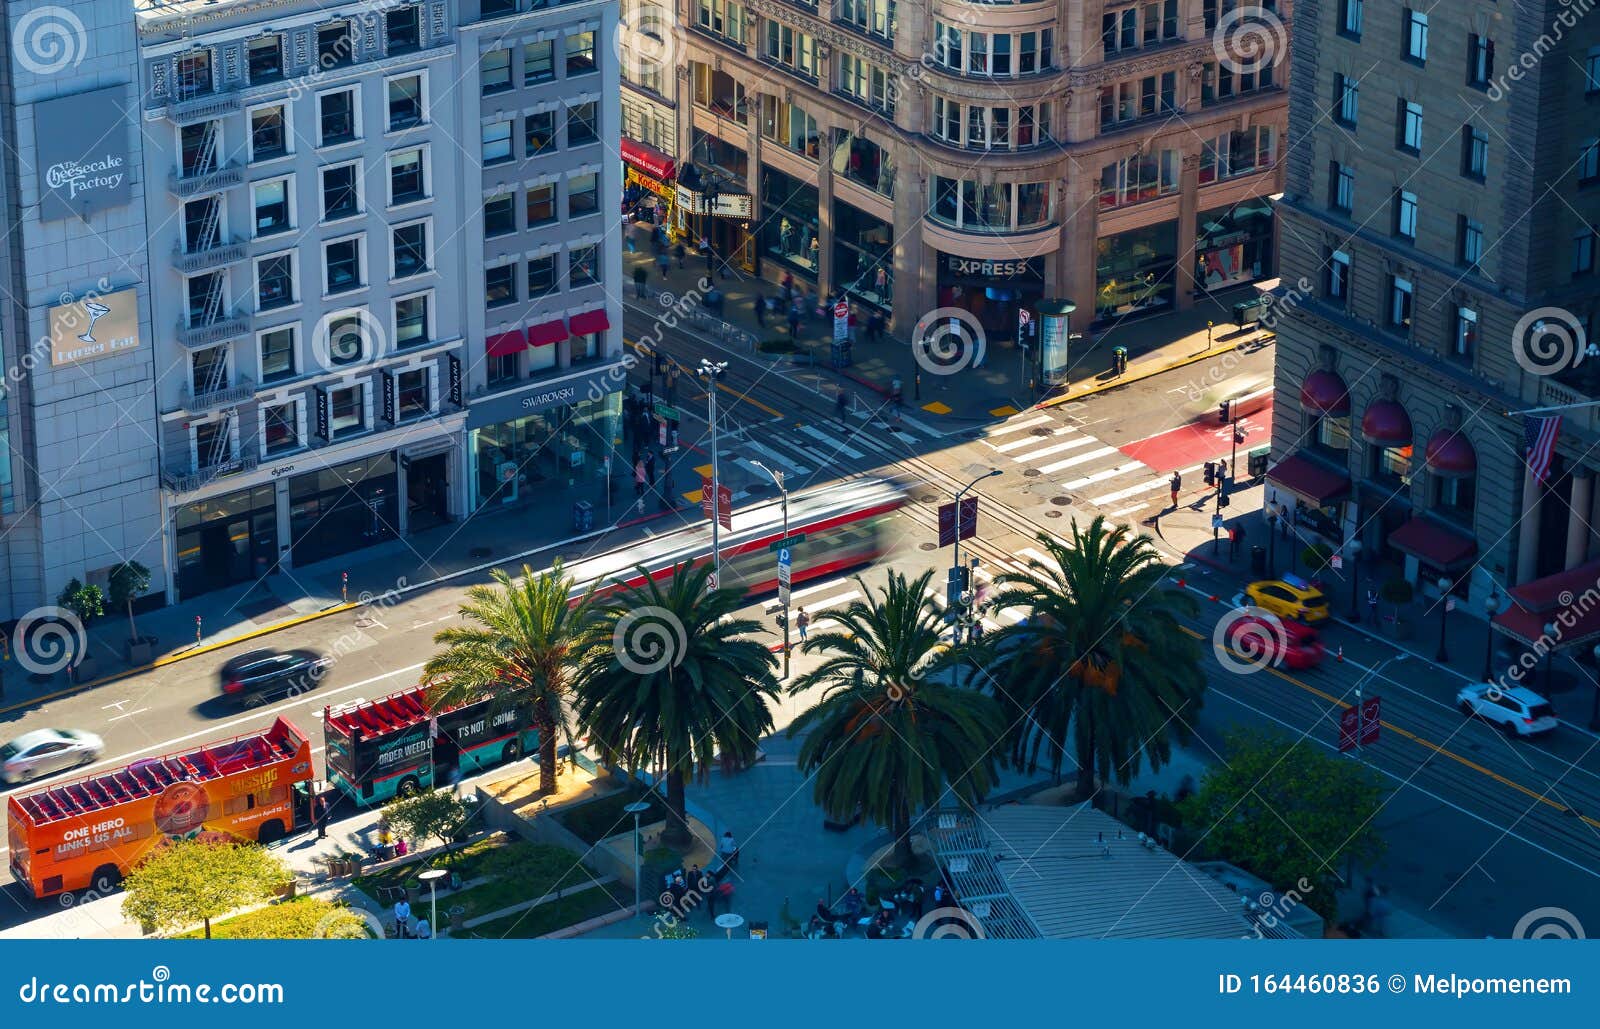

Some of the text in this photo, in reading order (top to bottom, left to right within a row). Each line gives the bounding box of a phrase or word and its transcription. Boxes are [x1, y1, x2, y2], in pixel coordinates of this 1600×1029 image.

[46, 155, 122, 188] Cheesecake
[62, 173, 123, 200] Factory
[637, 173, 661, 194] Kodak
[948, 257, 1026, 276] EXPRESS
[522, 387, 575, 409] SWAROVSKI
[271, 465, 295, 476] dyson
[470, 720, 485, 735] NOT
[378, 748, 404, 766] ORDER
[404, 740, 426, 756] WEED
[57, 837, 91, 853] LINKS
[112, 826, 133, 839] ALL
[63, 817, 125, 841] ONE HERO
